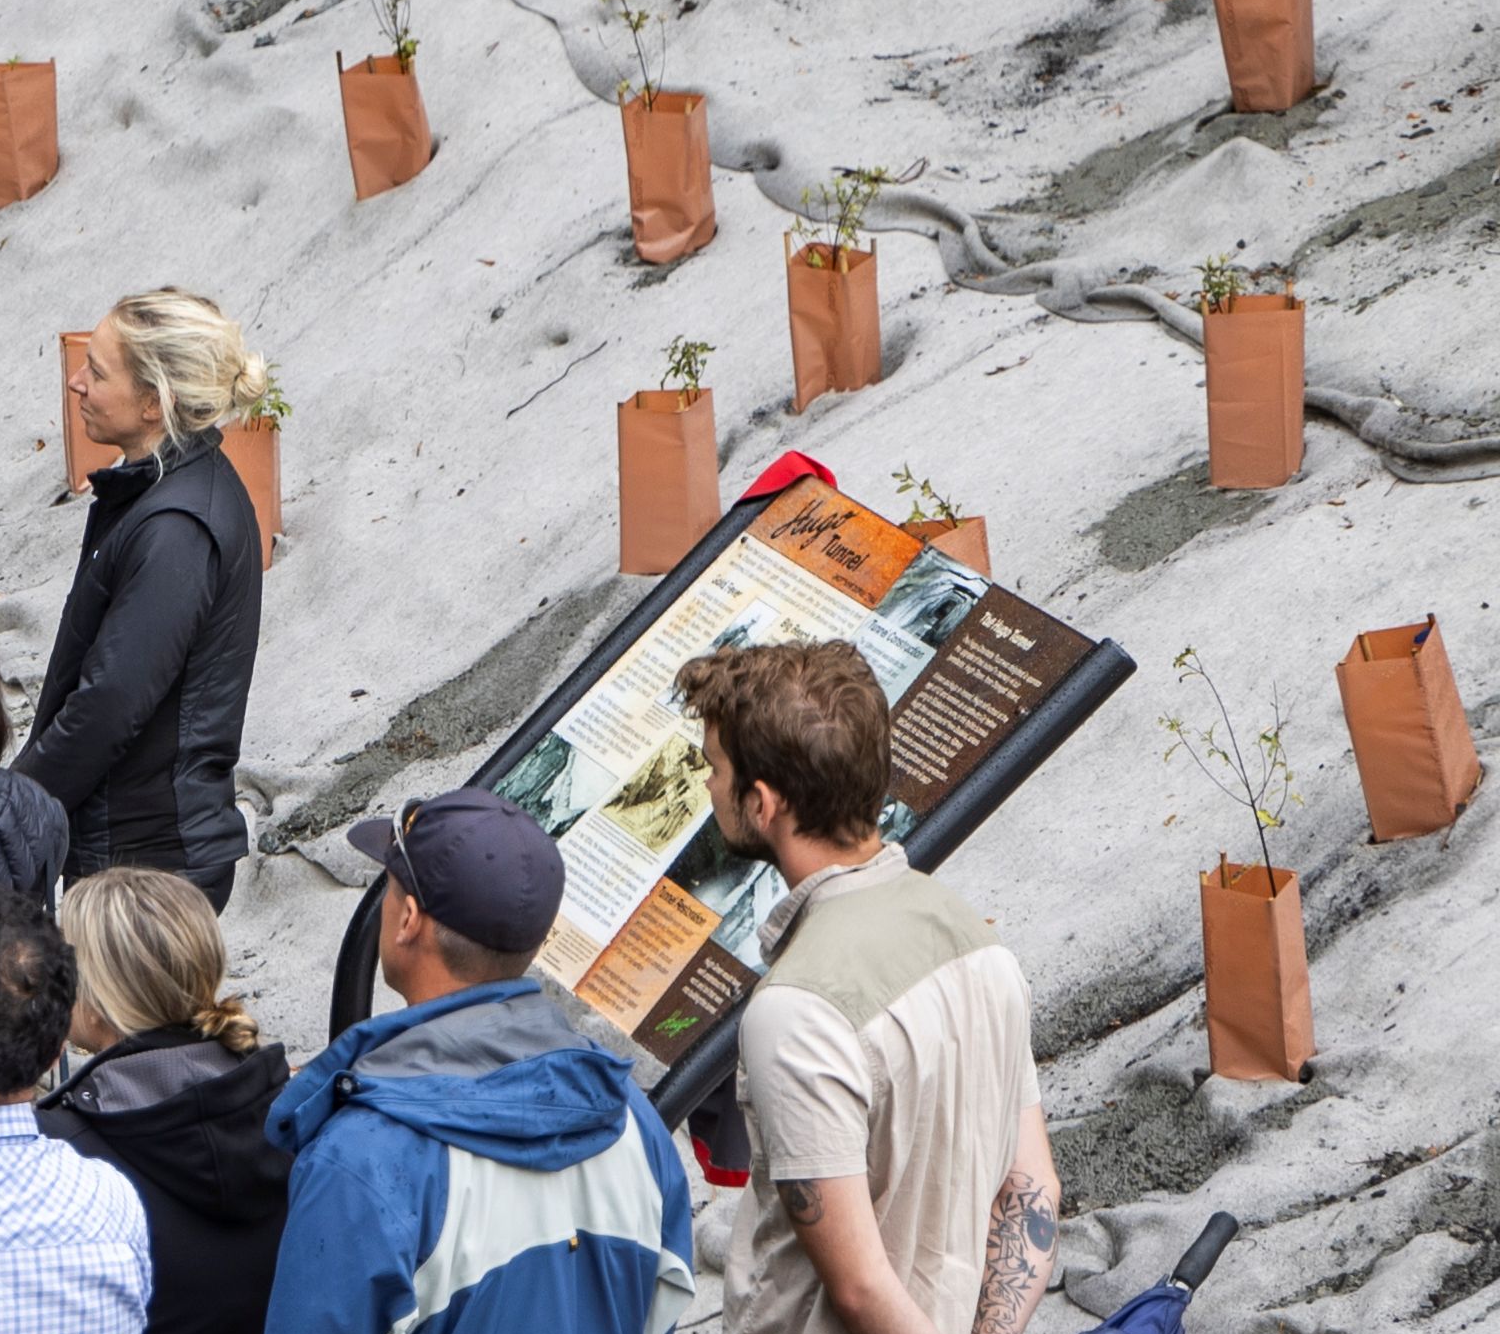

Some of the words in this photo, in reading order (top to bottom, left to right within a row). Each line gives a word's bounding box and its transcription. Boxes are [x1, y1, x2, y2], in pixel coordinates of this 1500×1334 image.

[770, 499, 859, 551] Hugo
[821, 534, 870, 573] Tunnel
[866, 618, 890, 641] Tunnel
[884, 627, 925, 661] Construction
